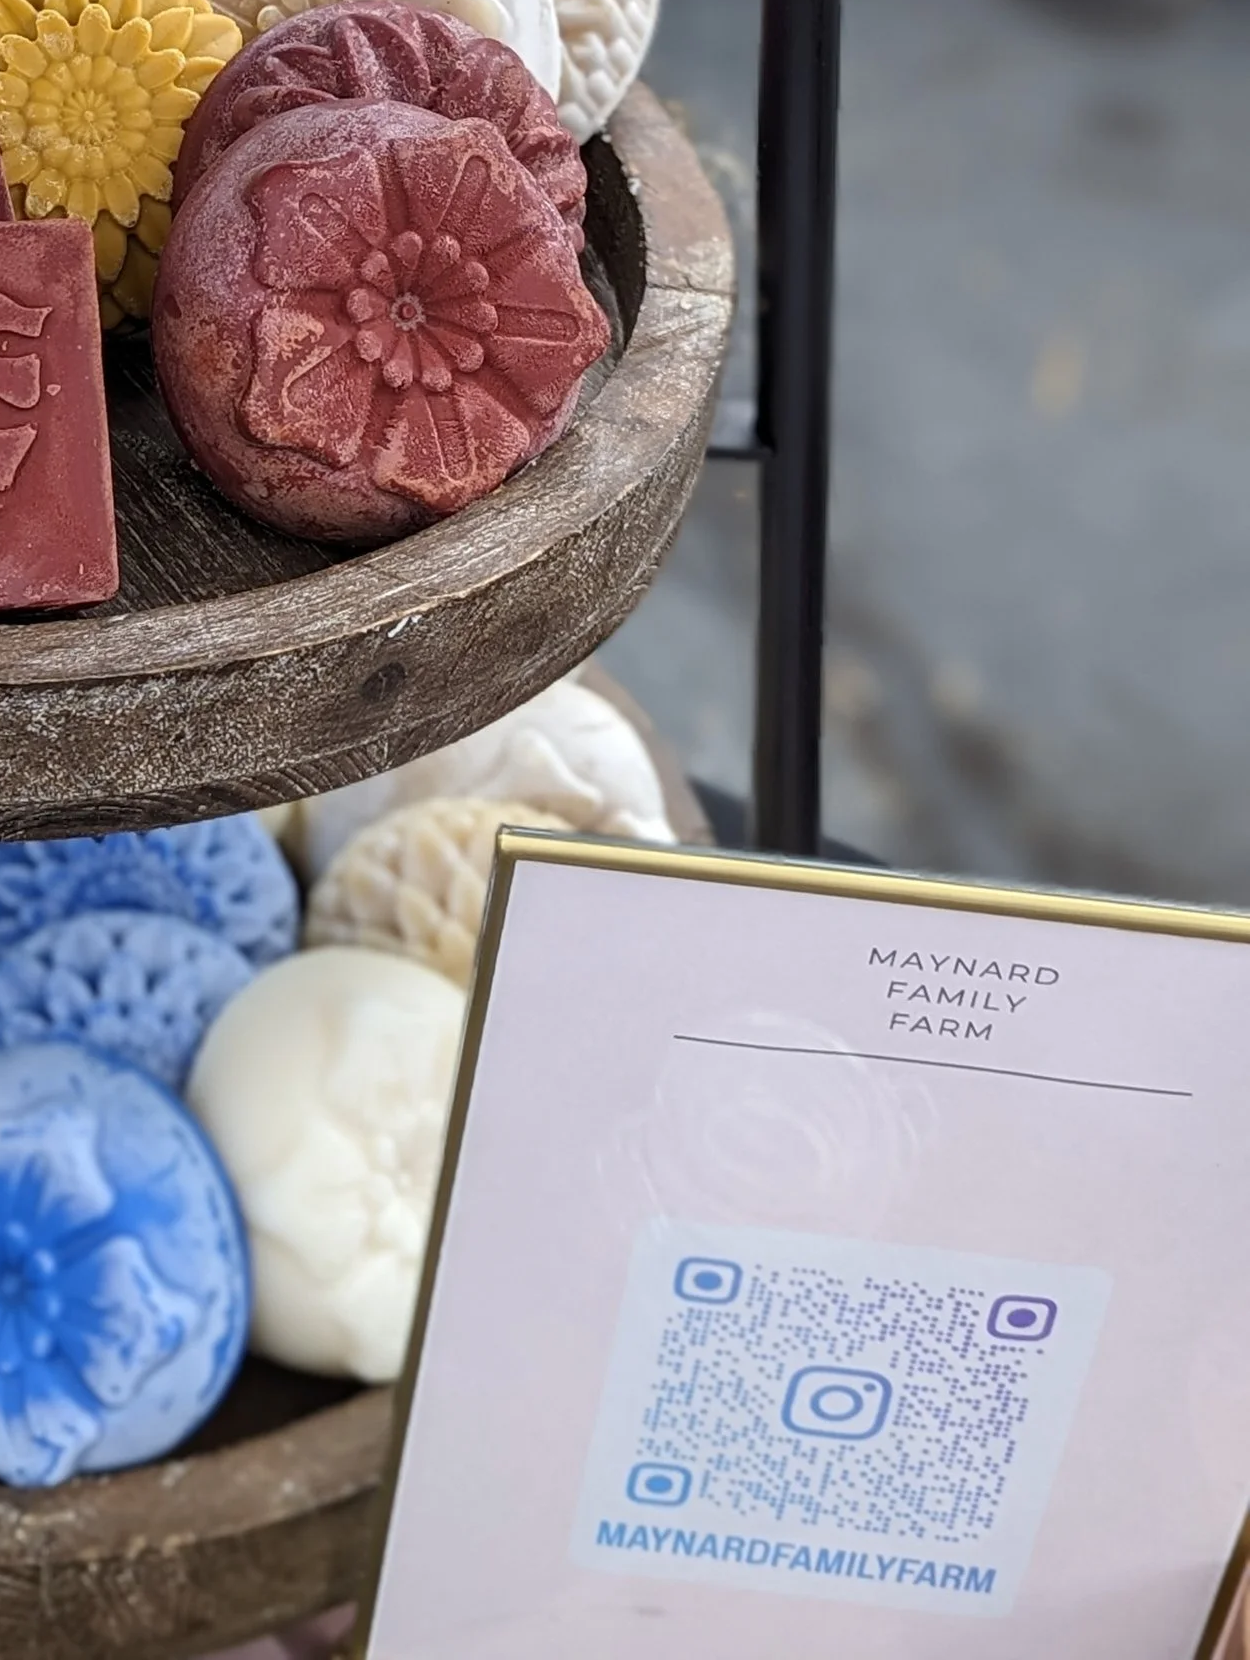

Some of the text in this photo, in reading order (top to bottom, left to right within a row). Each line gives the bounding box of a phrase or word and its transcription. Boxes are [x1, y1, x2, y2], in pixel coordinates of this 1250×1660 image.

[868, 947, 1059, 986] MAYNARD
[886, 980, 1027, 1013] FAMILY
[889, 1012, 993, 1041] FARM
[596, 1520, 997, 1594] MAYNARDFAMILYFARM
